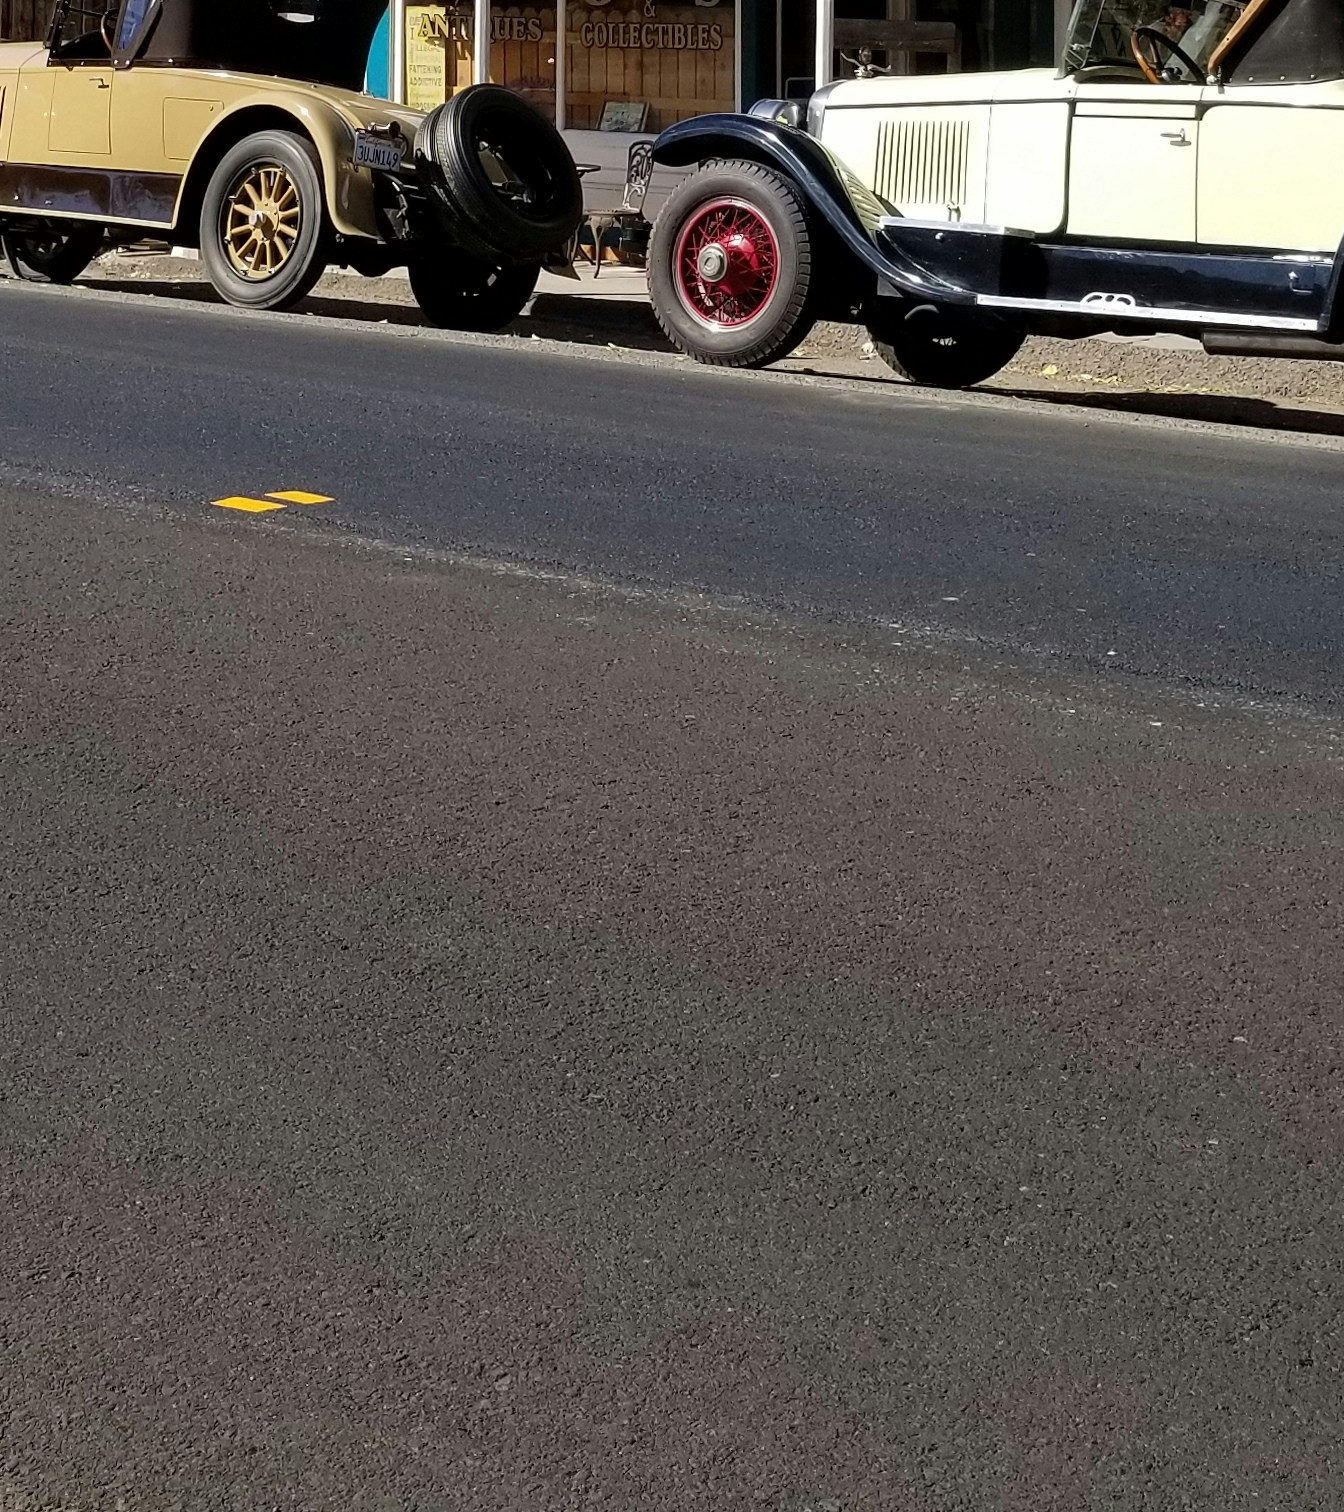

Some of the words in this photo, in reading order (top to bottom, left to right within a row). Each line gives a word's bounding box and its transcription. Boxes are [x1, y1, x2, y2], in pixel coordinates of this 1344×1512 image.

[418, 13, 544, 44] ANTIUES
[581, 22, 723, 50] COLLECTIBLES
[357, 145, 399, 167] 3UJN149
